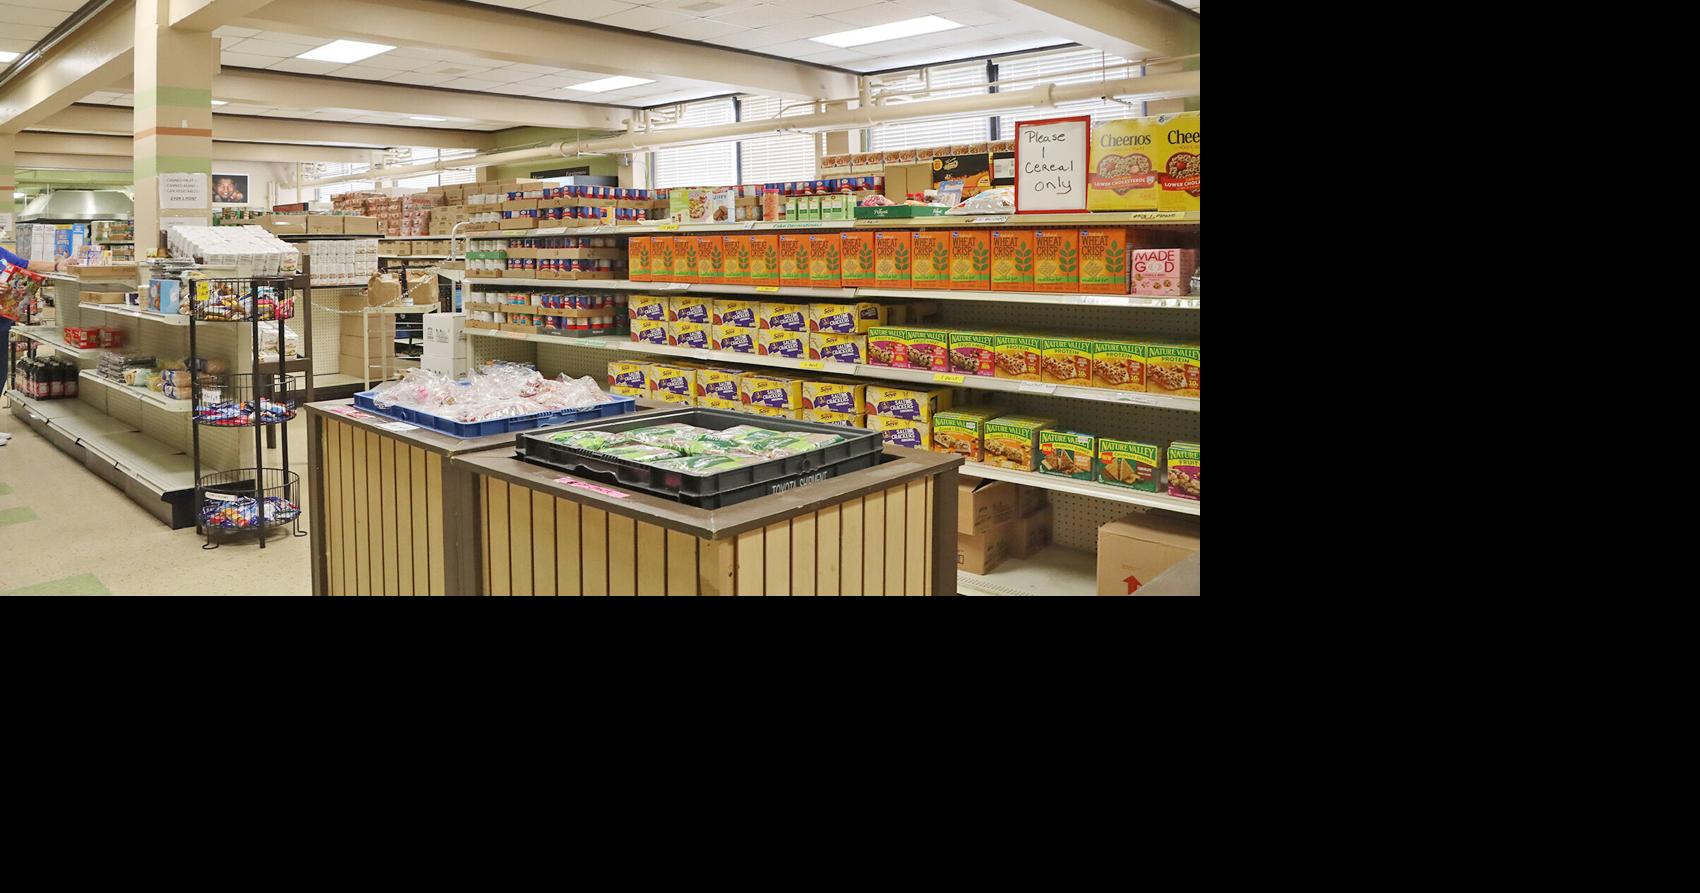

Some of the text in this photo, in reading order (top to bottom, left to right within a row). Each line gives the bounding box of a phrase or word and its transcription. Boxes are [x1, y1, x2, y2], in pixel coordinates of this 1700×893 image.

[1024, 130, 1066, 142] Please
[1100, 133, 1151, 148] Cheerios
[1112, 178, 1146, 186] CHOLESTEROL
[953, 238, 976, 246] WHEAT
[993, 237, 1018, 246] WHEAT
[1036, 237, 1061, 246] WHEAT
[1082, 236, 1109, 246] WHEAT
[993, 247, 1015, 256] CRISP
[1036, 247, 1058, 256] CRISP
[1082, 246, 1104, 256] CRISP
[1134, 250, 1175, 261] MADE
[888, 330, 906, 339] VALLEY
[927, 333, 945, 341] VALLEY
[952, 335, 991, 345] NATURE VALLEY
[997, 337, 1038, 347] NATURE VALLEY
[1044, 340, 1090, 352] NATURE VALLEY
[1095, 343, 1144, 356] NATURE VALLEY
[1149, 348, 1176, 357] NATURE
[935, 418, 955, 426] NATURE
[986, 424, 1008, 433] NATURE
[1009, 427, 1030, 439] VALLEY
[1042, 433, 1067, 443] NATURE
[1102, 441, 1128, 451] NATURE
[1128, 445, 1154, 458] VALLEY
[1170, 450, 1200, 459] NATURE
